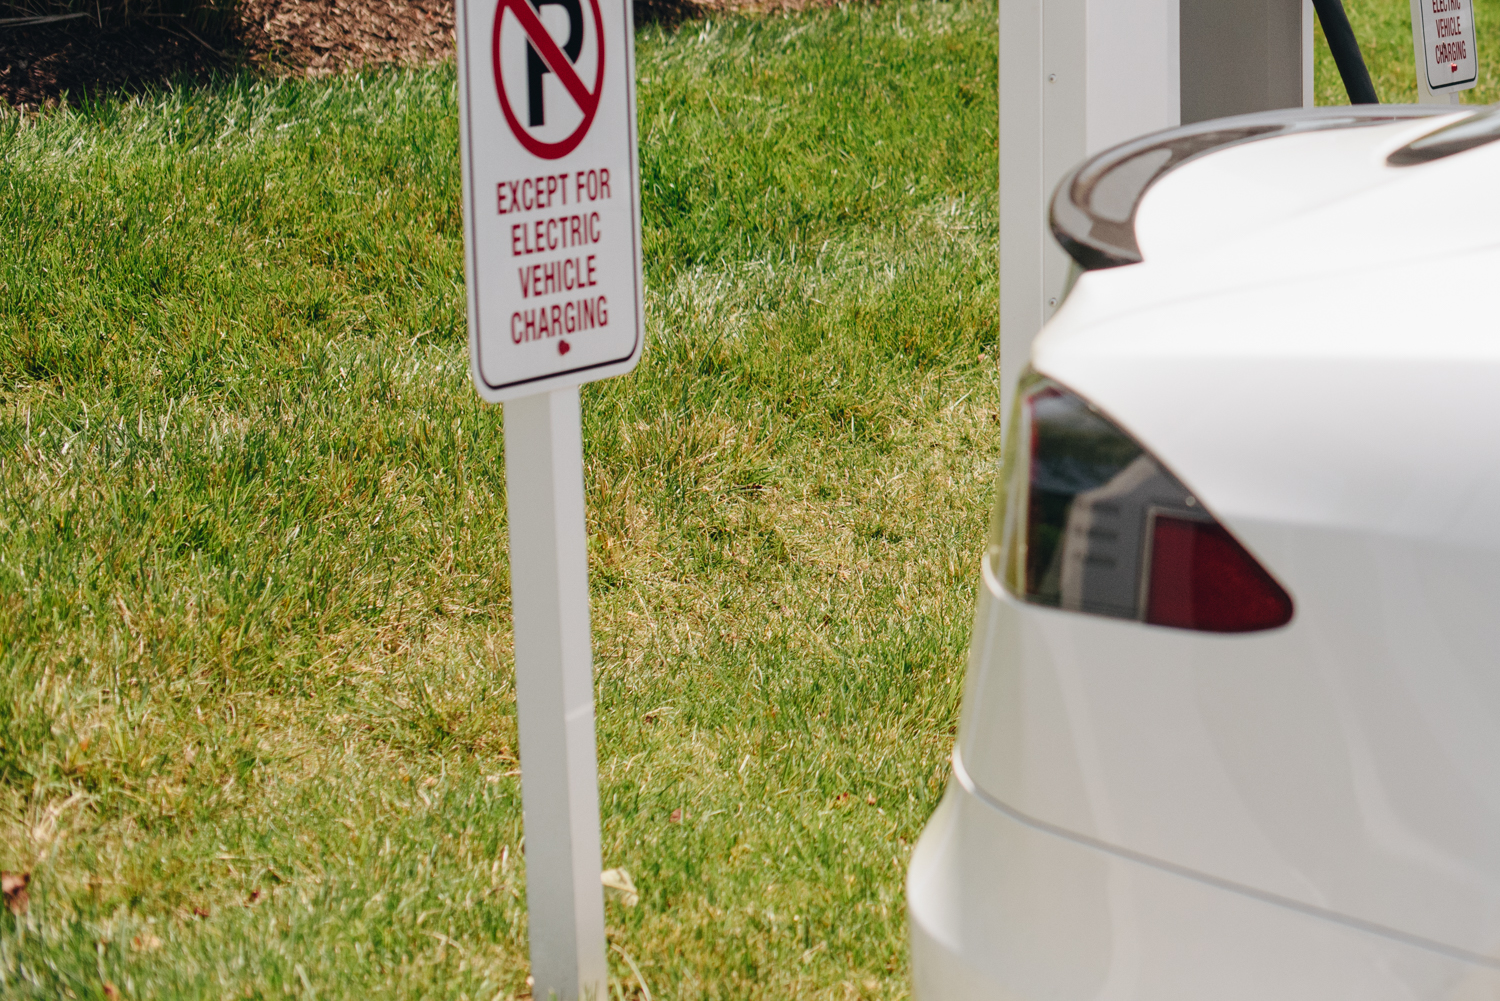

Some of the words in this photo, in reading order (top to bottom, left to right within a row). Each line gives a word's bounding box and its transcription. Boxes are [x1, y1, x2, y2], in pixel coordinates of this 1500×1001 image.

[1435, 15, 1462, 38] VEHICLE
[1435, 40, 1467, 65] CHARGING
[496, 172, 570, 216] EXCEPT
[576, 167, 612, 204] FOR
[511, 211, 602, 257] ELECTRIC
[518, 254, 598, 299] VEHICLE
[510, 295, 609, 345] CHARGING
